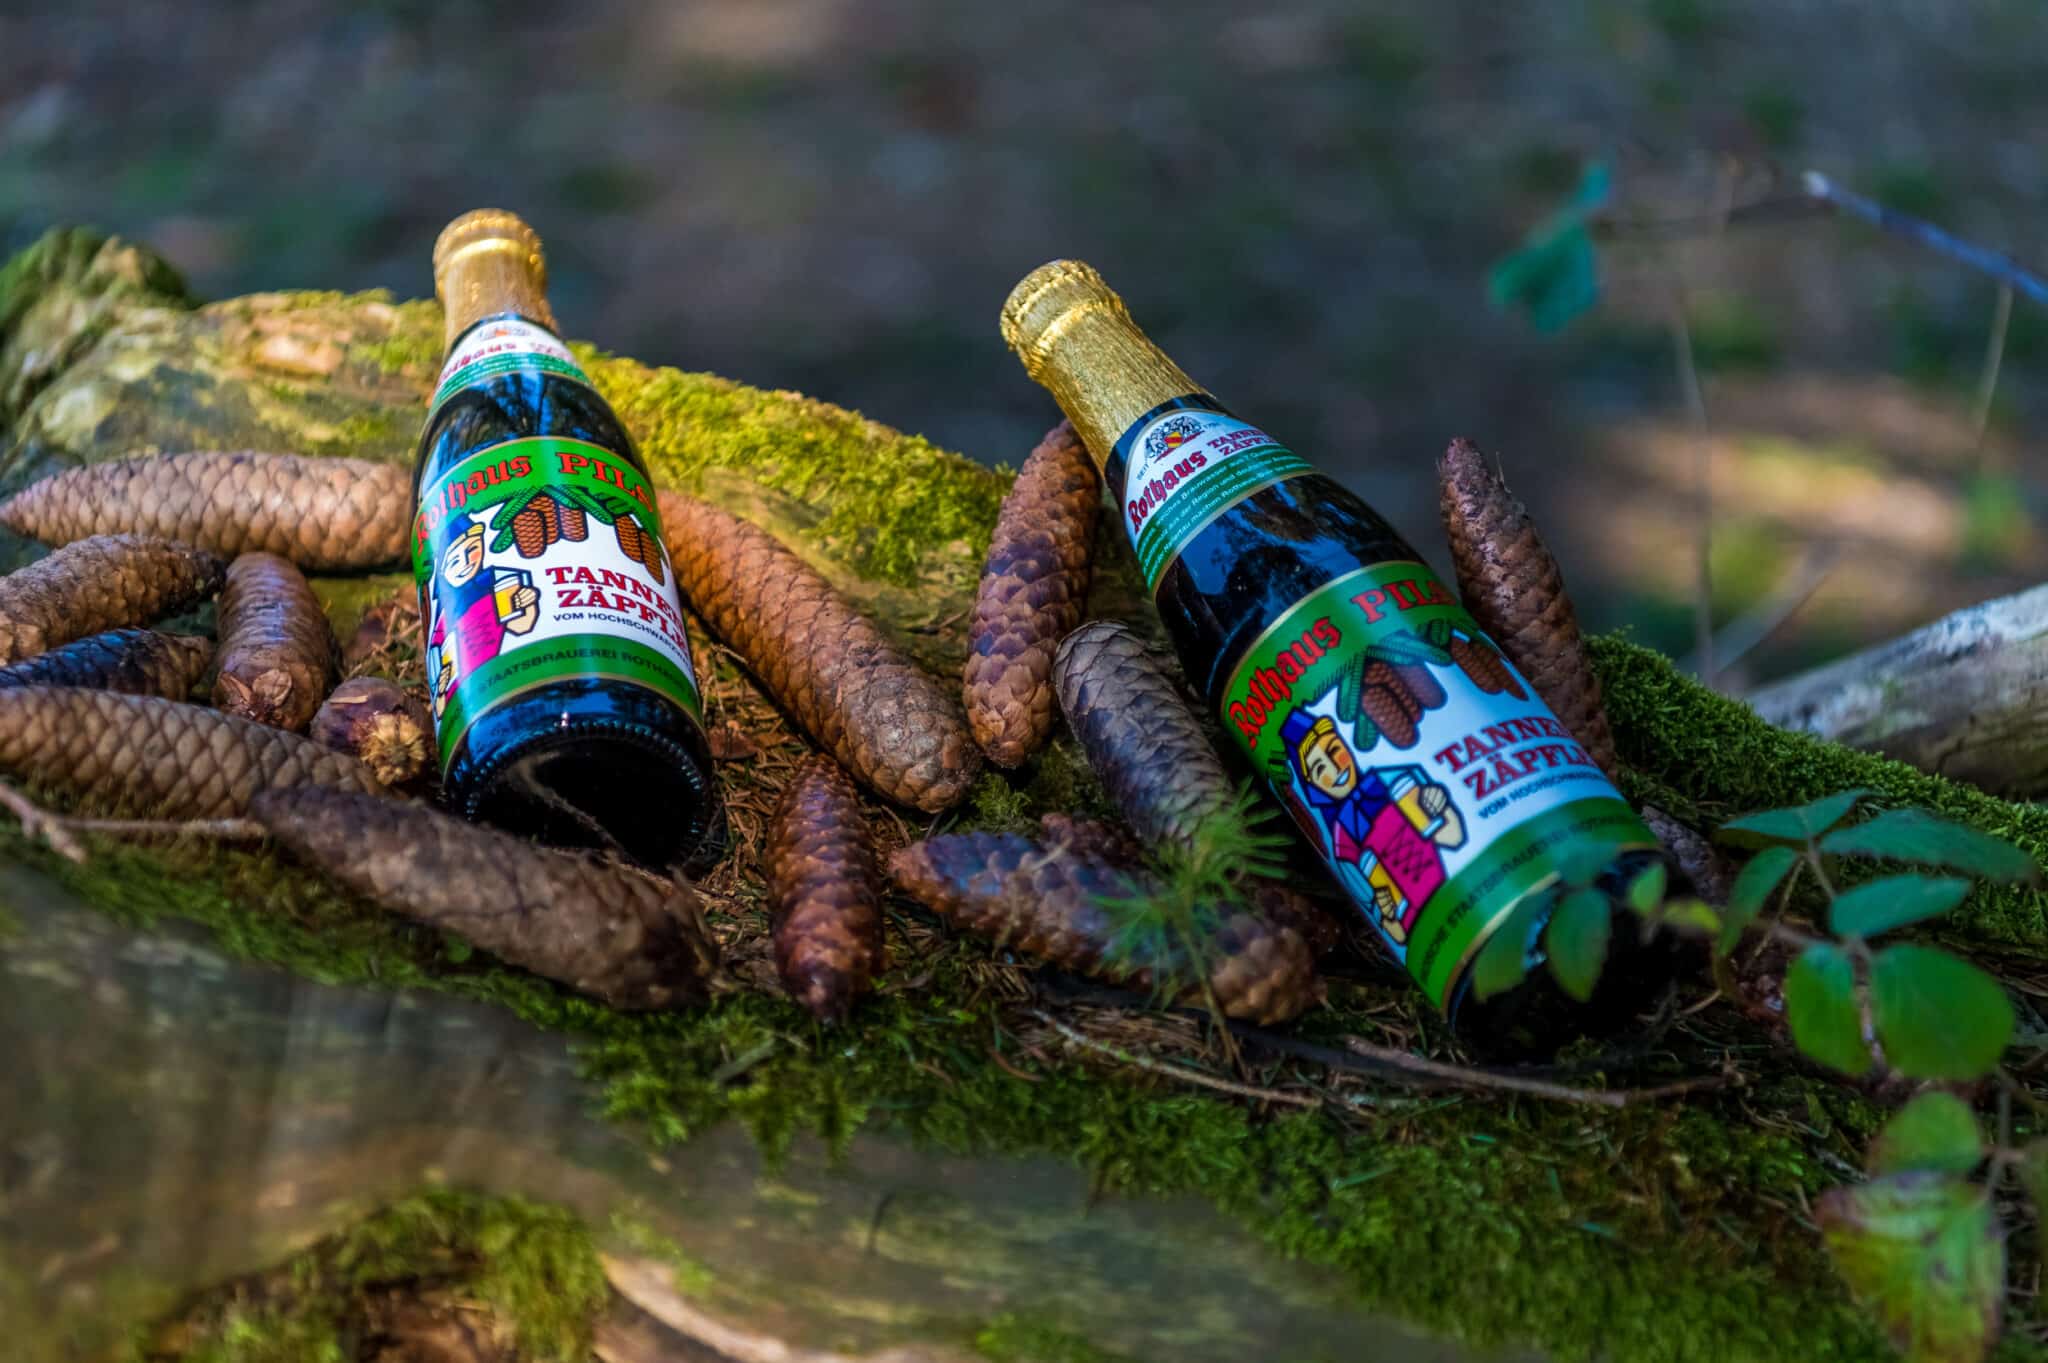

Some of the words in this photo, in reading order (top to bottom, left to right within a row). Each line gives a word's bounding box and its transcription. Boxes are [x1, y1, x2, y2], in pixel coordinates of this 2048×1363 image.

[415, 455, 532, 555] Rothaus
[555, 452, 654, 513] PILS
[1128, 450, 1208, 535] Rothaus
[1191, 483, 1219, 506] Region
[1190, 495, 1221, 522] machen
[553, 612, 584, 622] VOM
[1229, 616, 1341, 750] Rothaus
[1478, 797, 1510, 819] VOM
